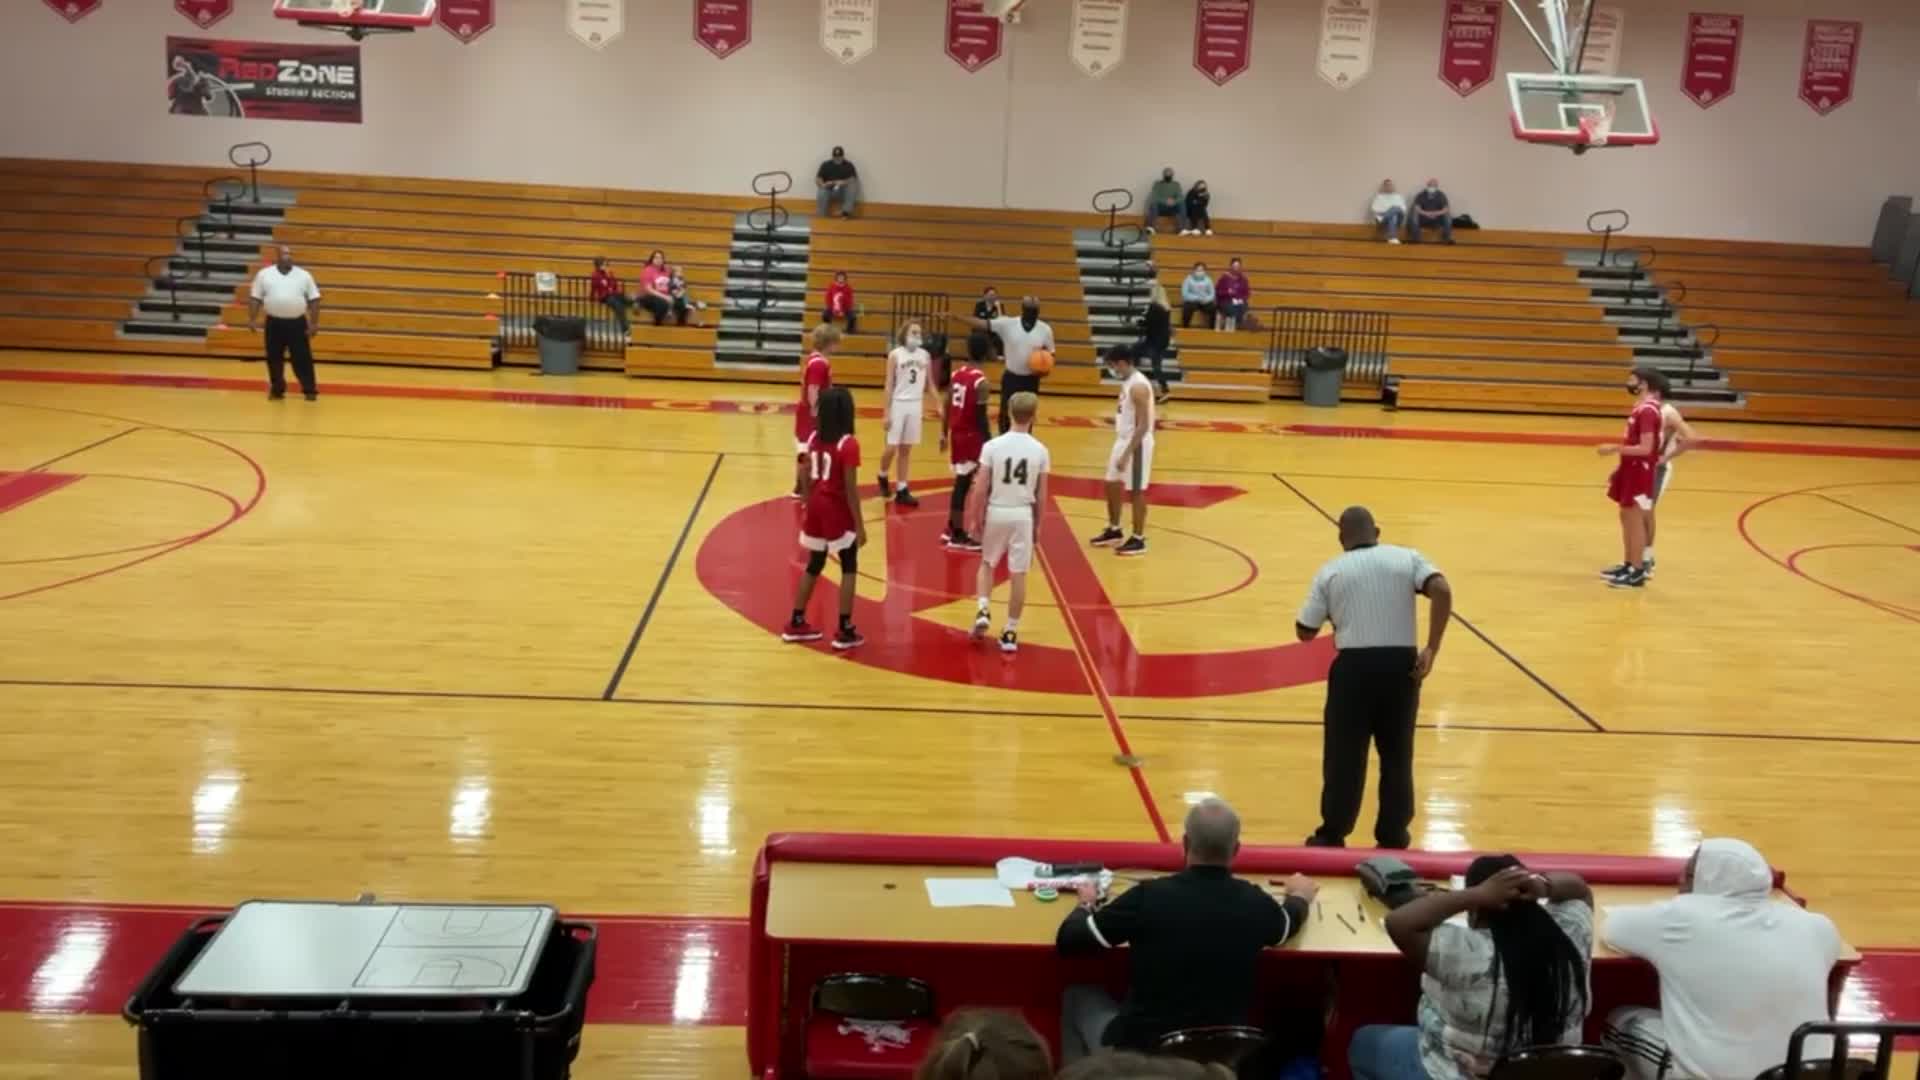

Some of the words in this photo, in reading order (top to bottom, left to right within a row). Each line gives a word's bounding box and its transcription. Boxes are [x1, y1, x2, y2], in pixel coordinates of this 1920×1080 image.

[265, 86, 309, 97] STUDENT
[312, 88, 356, 100] SECTION
[909, 369, 918, 385] 3
[951, 383, 967, 409] 21
[1002, 456, 1028, 485] 14
